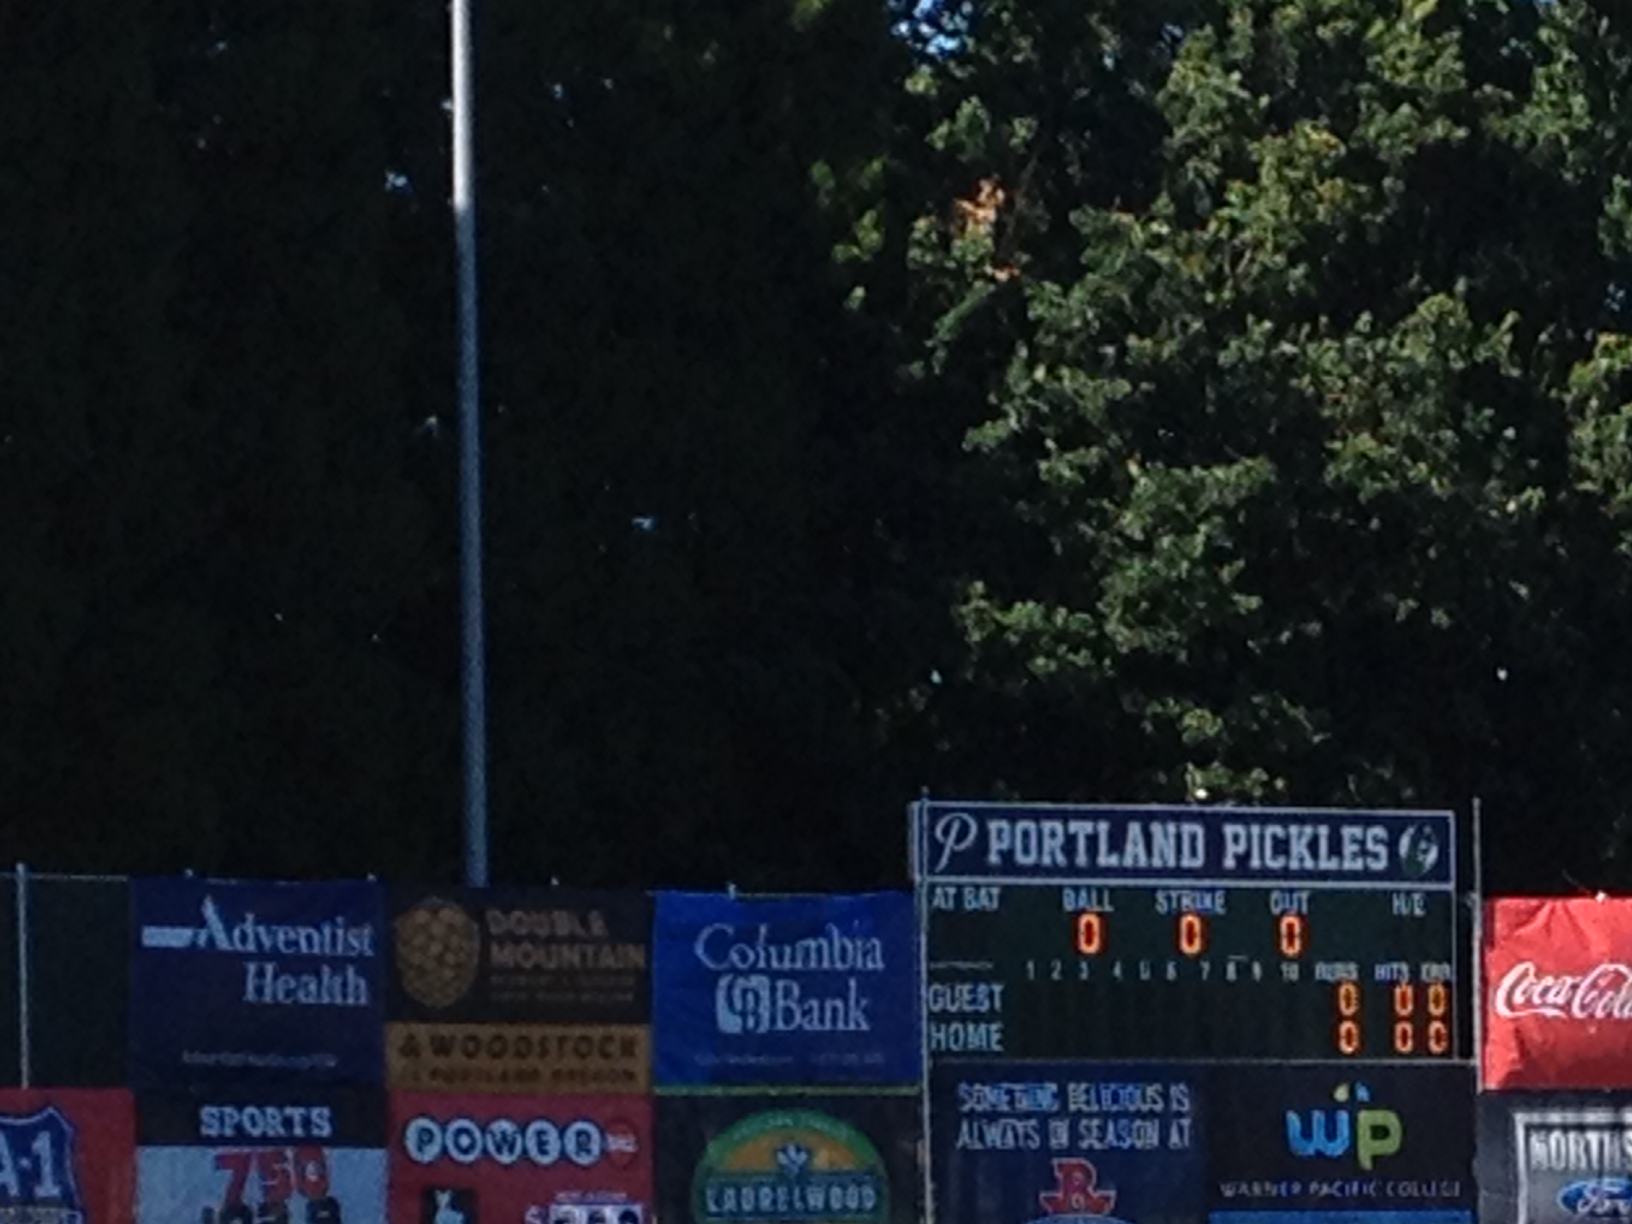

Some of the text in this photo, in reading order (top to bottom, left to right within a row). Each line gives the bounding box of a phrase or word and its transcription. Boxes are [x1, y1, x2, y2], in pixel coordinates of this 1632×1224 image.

[987, 819, 1389, 871] PORTLAND PICKLES
[932, 887, 1000, 910] AT BAT
[1062, 888, 1114, 912] BALL
[1155, 889, 1226, 915] STRIKE
[1269, 890, 1311, 915] OUT
[197, 893, 375, 957] Adventist
[484, 910, 610, 937] DOUBLE
[1079, 912, 1301, 956] 0 0 0
[490, 941, 646, 970] MOUNTAIN
[693, 919, 886, 972] Columbia
[243, 961, 370, 1005] Health
[1026, 960, 1036, 982] 1
[1051, 960, 1062, 982] 2
[1112, 960, 1123, 982] 4
[1200, 960, 1211, 982] 7
[1280, 960, 1300, 982] 10
[1374, 962, 1410, 983] HITS
[771, 976, 871, 1031] Bank
[928, 984, 1004, 1013] GUEST
[1395, 983, 1413, 1017] 0
[1428, 983, 1446, 1017] 0
[429, 1034, 638, 1060] WOODSTOCK
[929, 1021, 1004, 1051] HOME
[1339, 1020, 1359, 1055] 0
[1395, 1020, 1413, 1055] 0
[957, 1082, 1191, 1112] SOMETHING DELICIOUS IS
[200, 1105, 333, 1138] SPORTS
[955, 1119, 1192, 1149] ALWAYS IN SEASON AT
[706, 1185, 877, 1213] LAURELWOOD
[1219, 1180, 1461, 1199] WARNER PACIFIC COLLEGE
